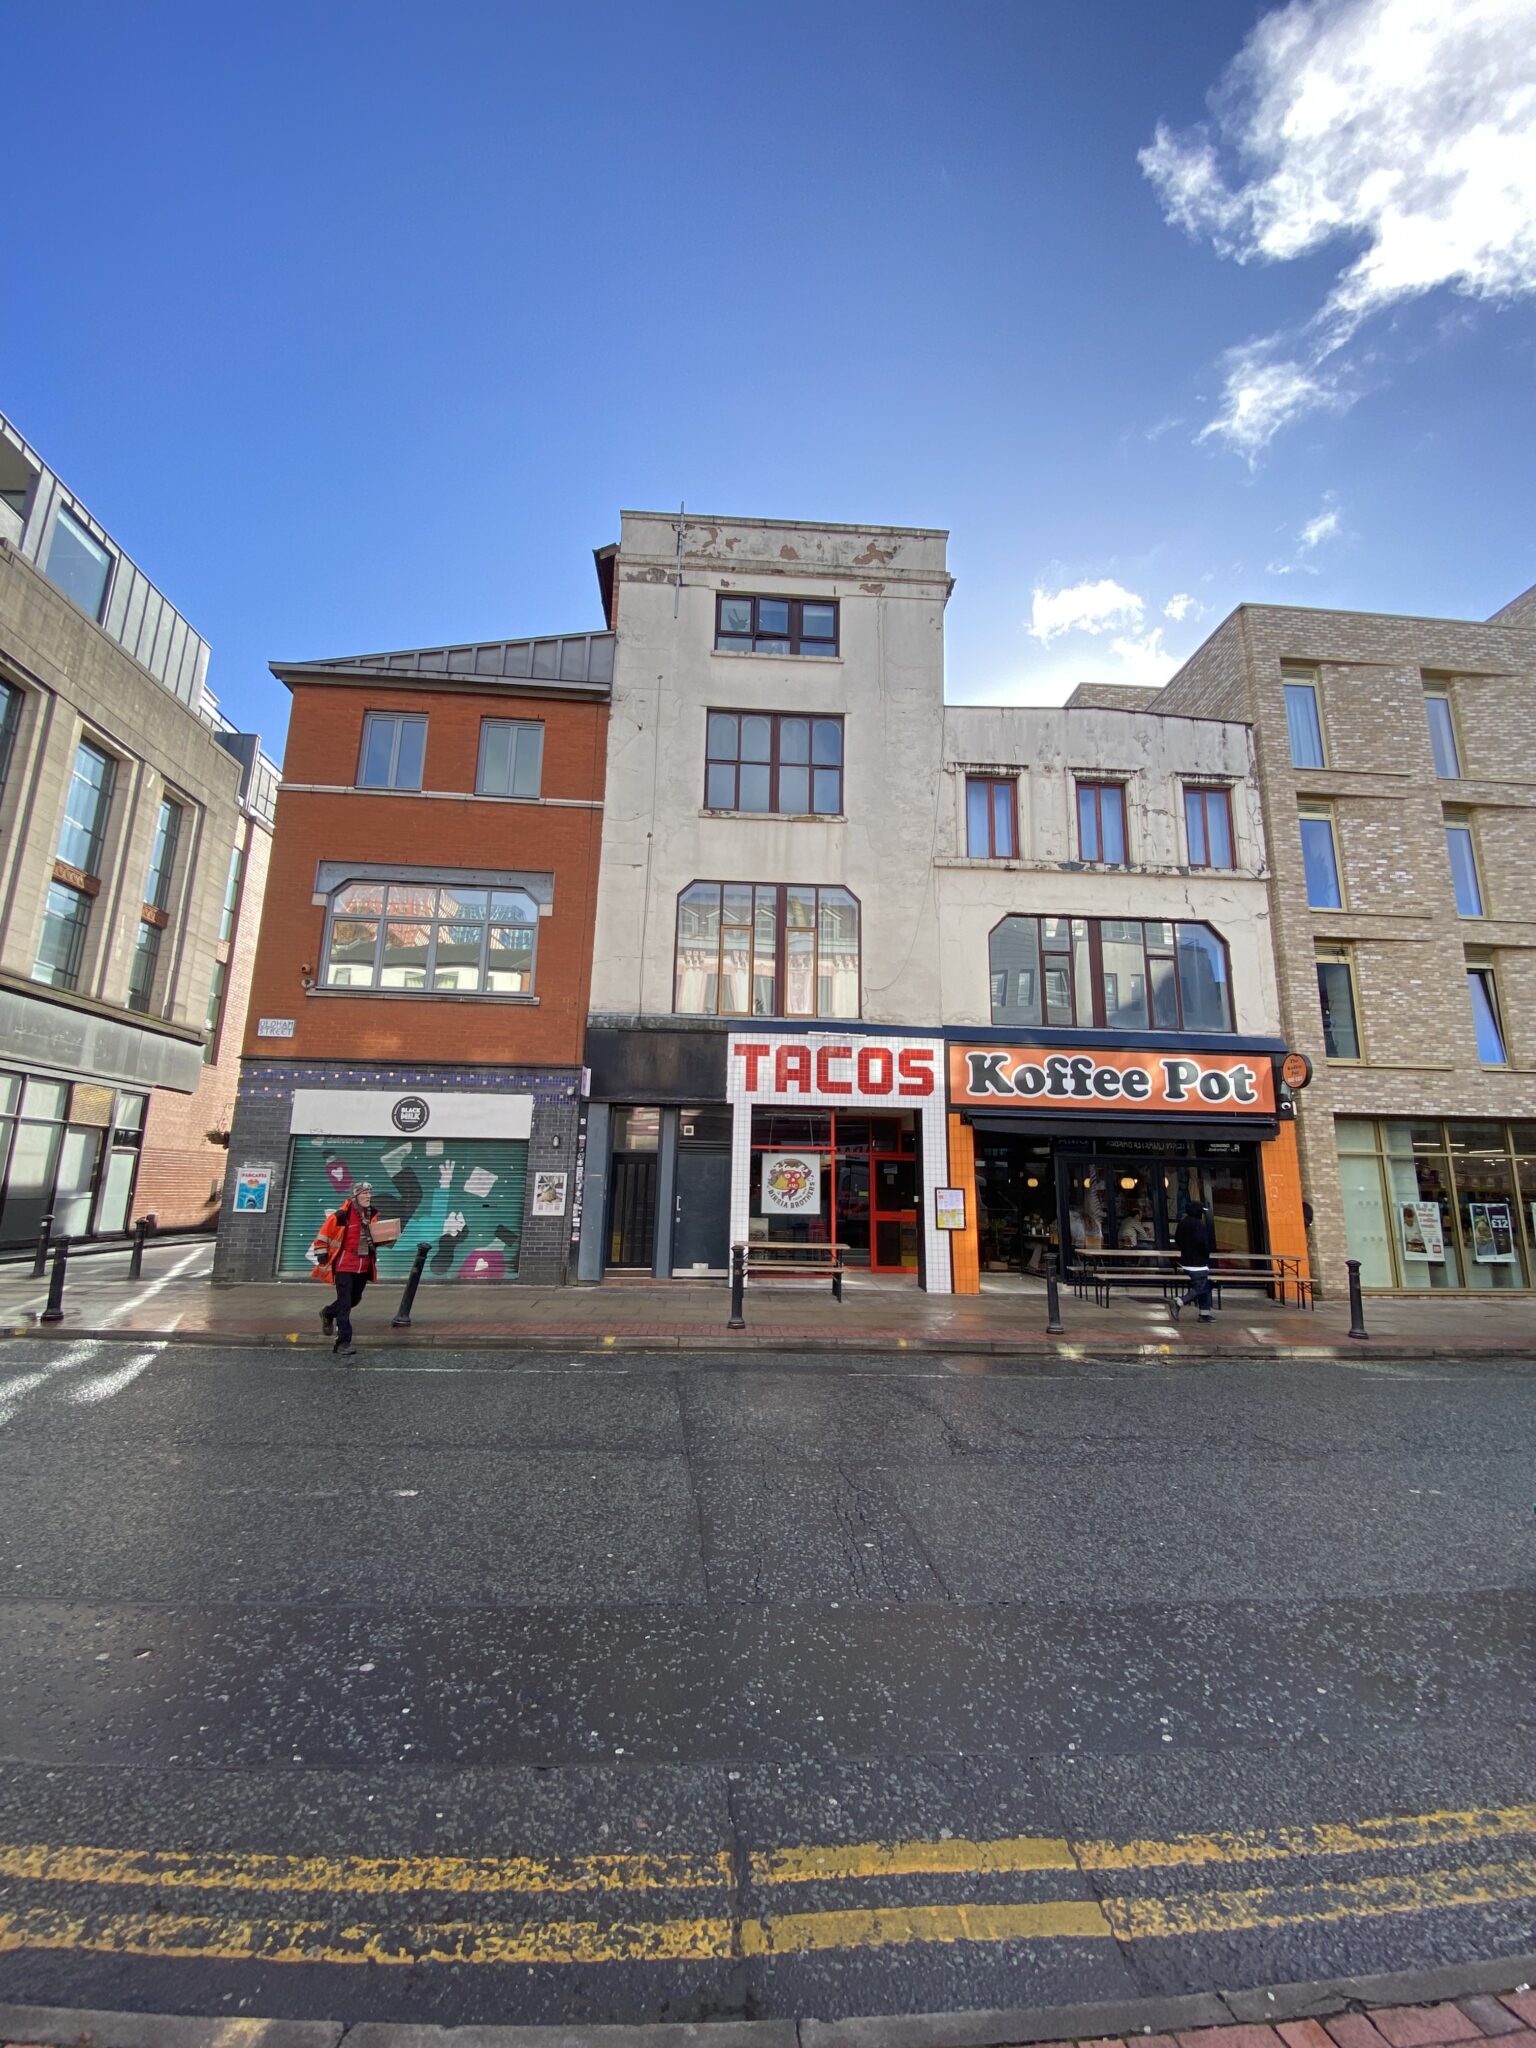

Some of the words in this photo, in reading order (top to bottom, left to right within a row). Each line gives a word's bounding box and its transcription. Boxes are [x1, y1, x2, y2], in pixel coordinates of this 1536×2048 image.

[259, 1020, 294, 1029] OLDHAM
[258, 1028, 293, 1036] STREET
[734, 1044, 934, 1096] TACOS
[965, 1051, 1153, 1102] Koffee
[1159, 1057, 1258, 1105] Pot
[400, 1112, 421, 1120] MILK
[790, 1181, 816, 1209] BROTHERS
[1491, 1219, 1510, 1229] £12
